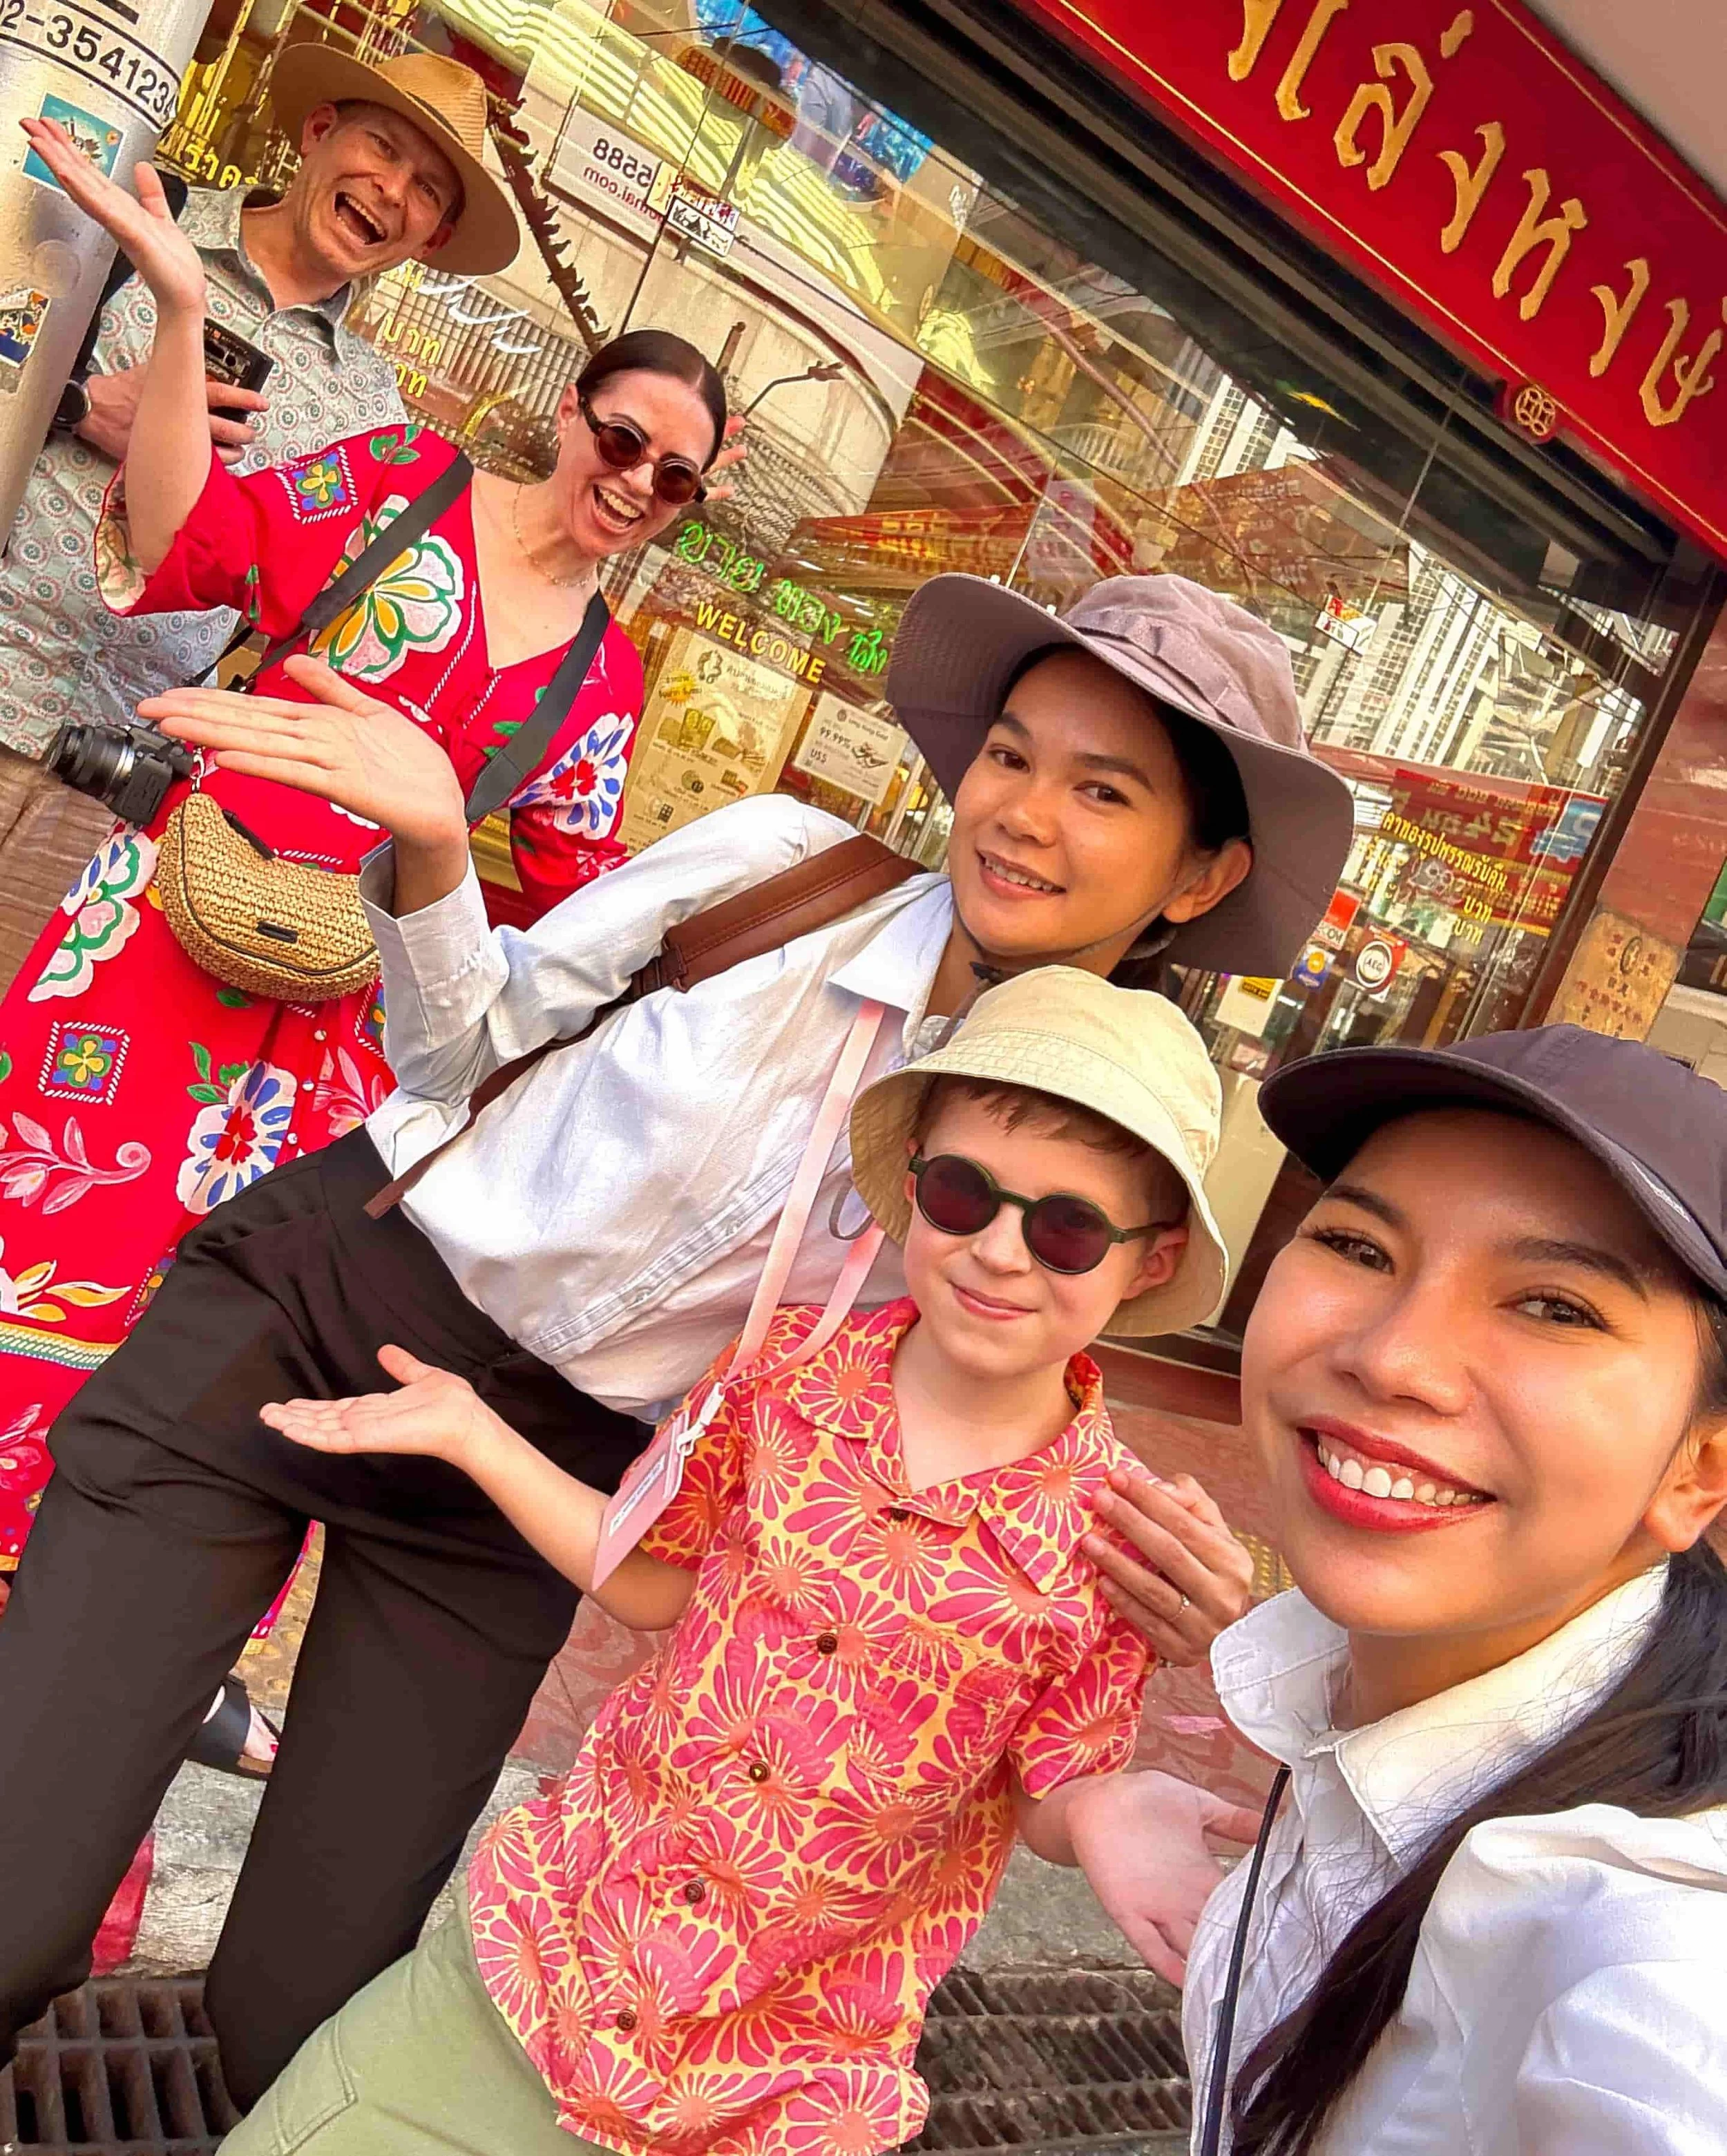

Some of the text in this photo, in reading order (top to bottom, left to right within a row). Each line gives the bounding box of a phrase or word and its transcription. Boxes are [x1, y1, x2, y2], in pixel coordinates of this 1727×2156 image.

[0, 0, 175, 122] 2-3541234
[383, 314, 441, 365] บาท
[680, 522, 765, 592] ขาย
[696, 600, 827, 684] WELCOME
[1462, 895, 1493, 926] บาท
